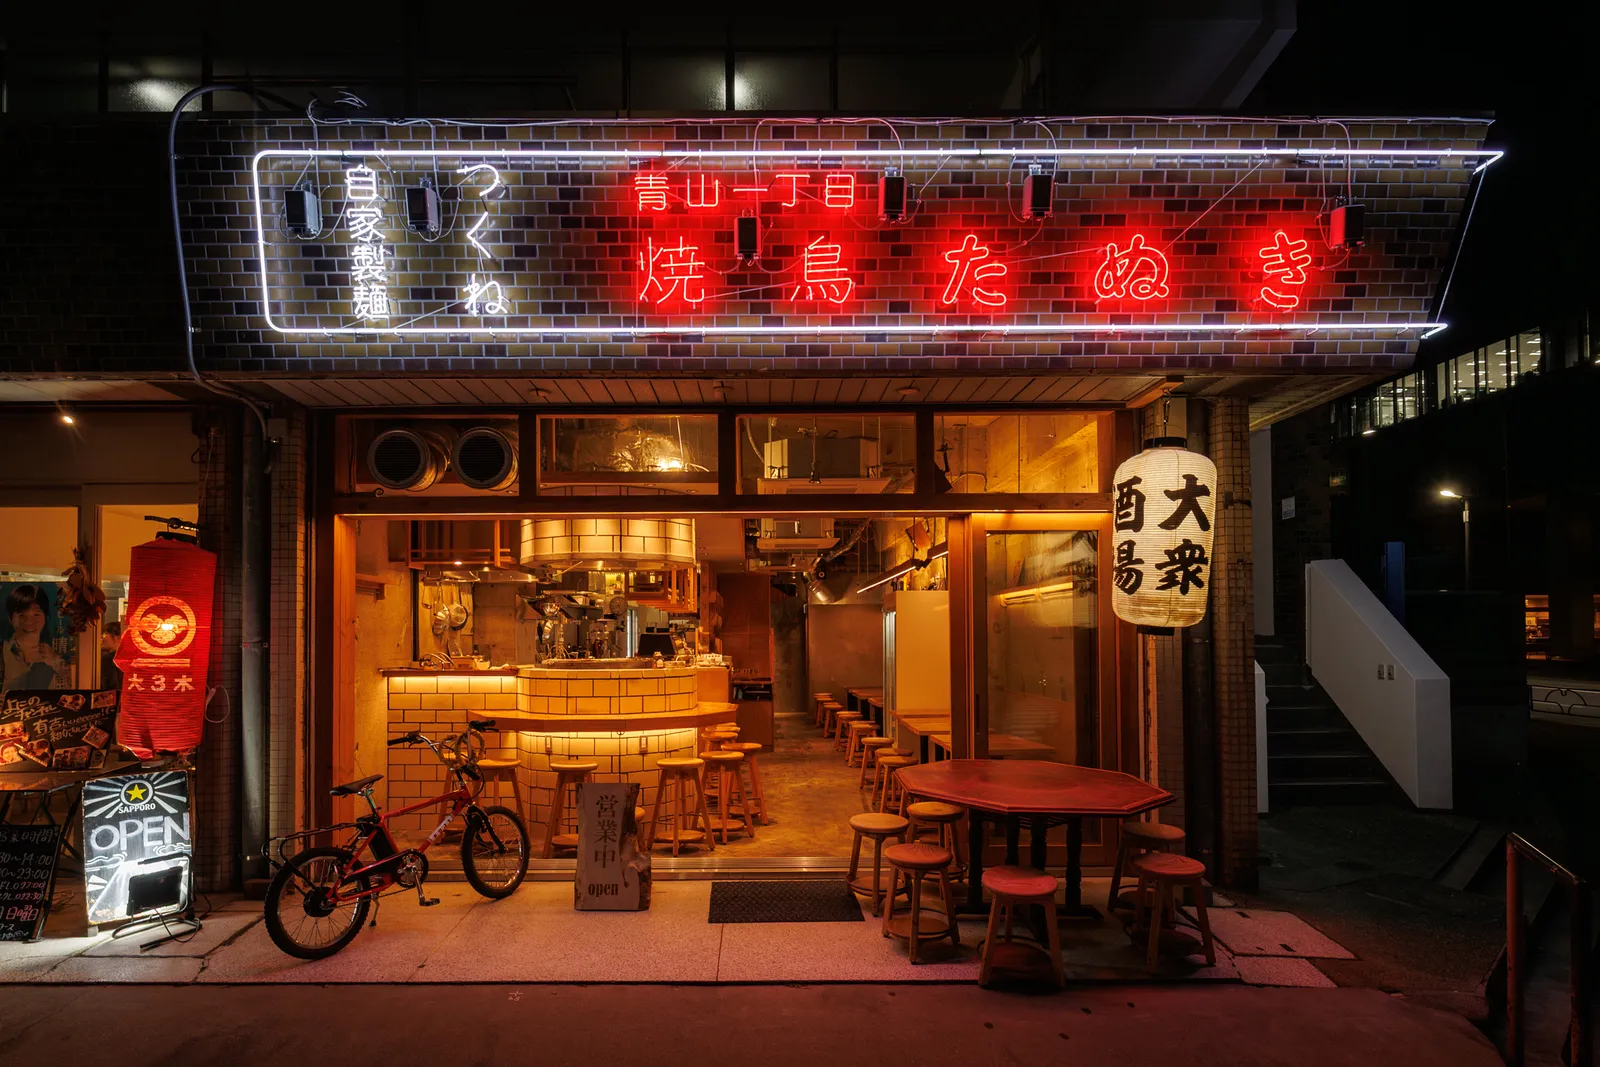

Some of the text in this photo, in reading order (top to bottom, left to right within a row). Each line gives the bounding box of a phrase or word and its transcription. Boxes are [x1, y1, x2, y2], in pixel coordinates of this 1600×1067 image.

[634, 173, 854, 211] 青山一丁目
[346, 164, 389, 320] 自家製麺
[456, 164, 509, 317] つくね
[118, 803, 156, 814] SAPPORO
[90, 812, 190, 851] OPEN
[594, 794, 619, 869] 営業中
[588, 883, 619, 897] open
